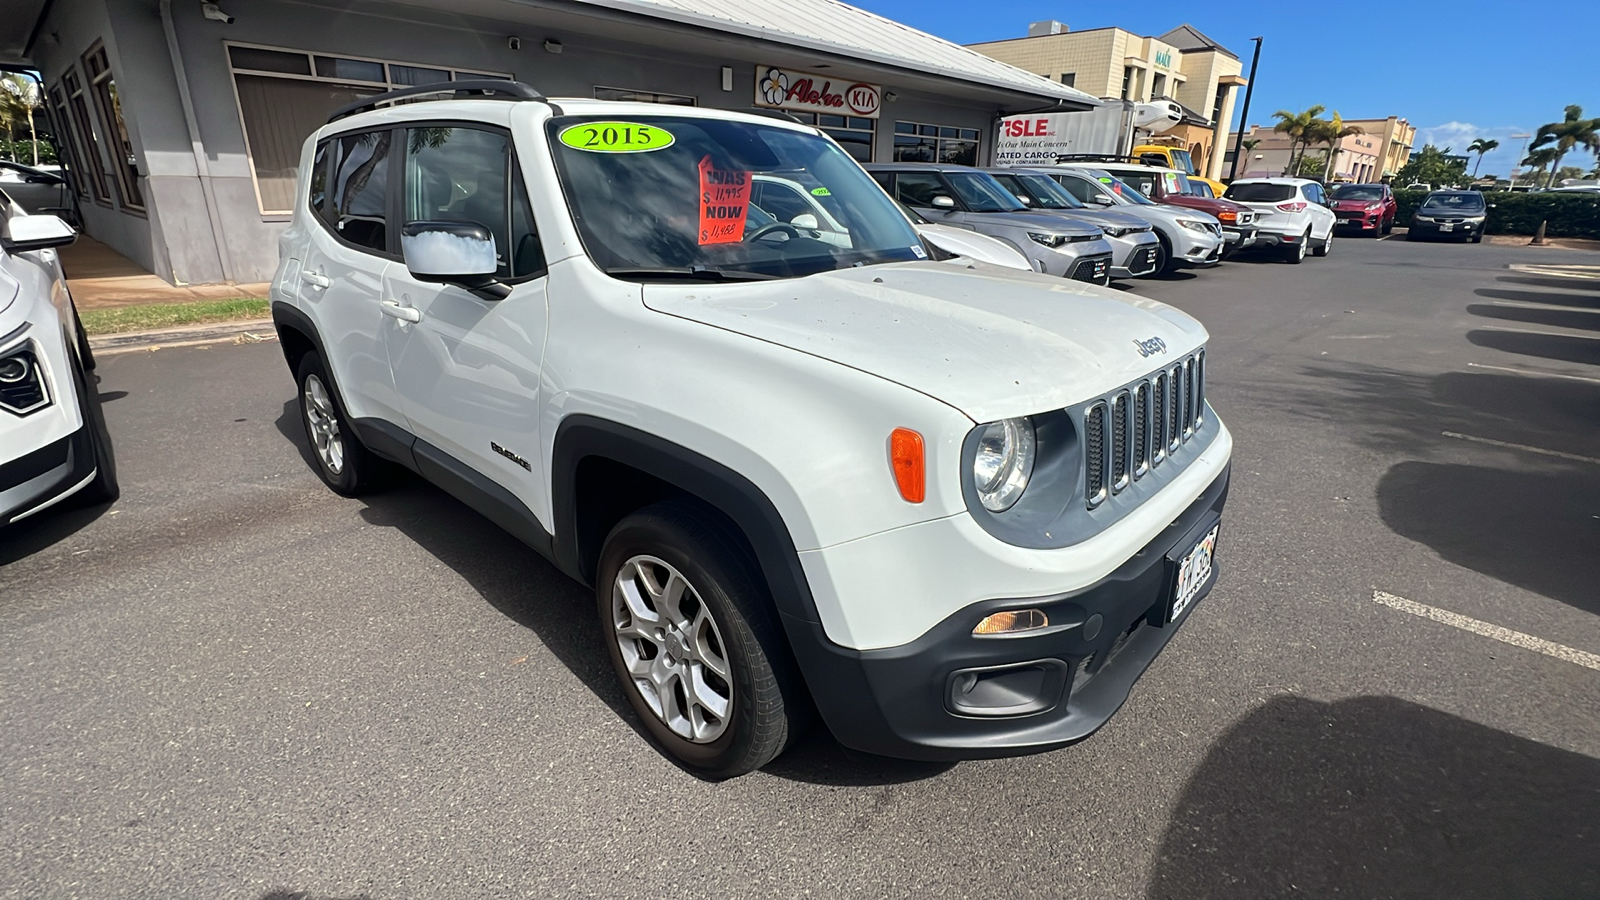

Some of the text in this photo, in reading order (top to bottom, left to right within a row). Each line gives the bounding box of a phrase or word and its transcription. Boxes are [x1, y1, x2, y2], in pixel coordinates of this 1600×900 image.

[785, 79, 875, 108] Aloha KIA
[1004, 119, 1048, 137] ISLE
[583, 127, 652, 147] 2015
[1024, 151, 1058, 159] CARGO
[707, 171, 745, 186] WAS
[703, 191, 710, 204] $
[706, 205, 743, 219] NOW
[701, 229, 709, 241] $
[1132, 336, 1167, 358] Jeep
